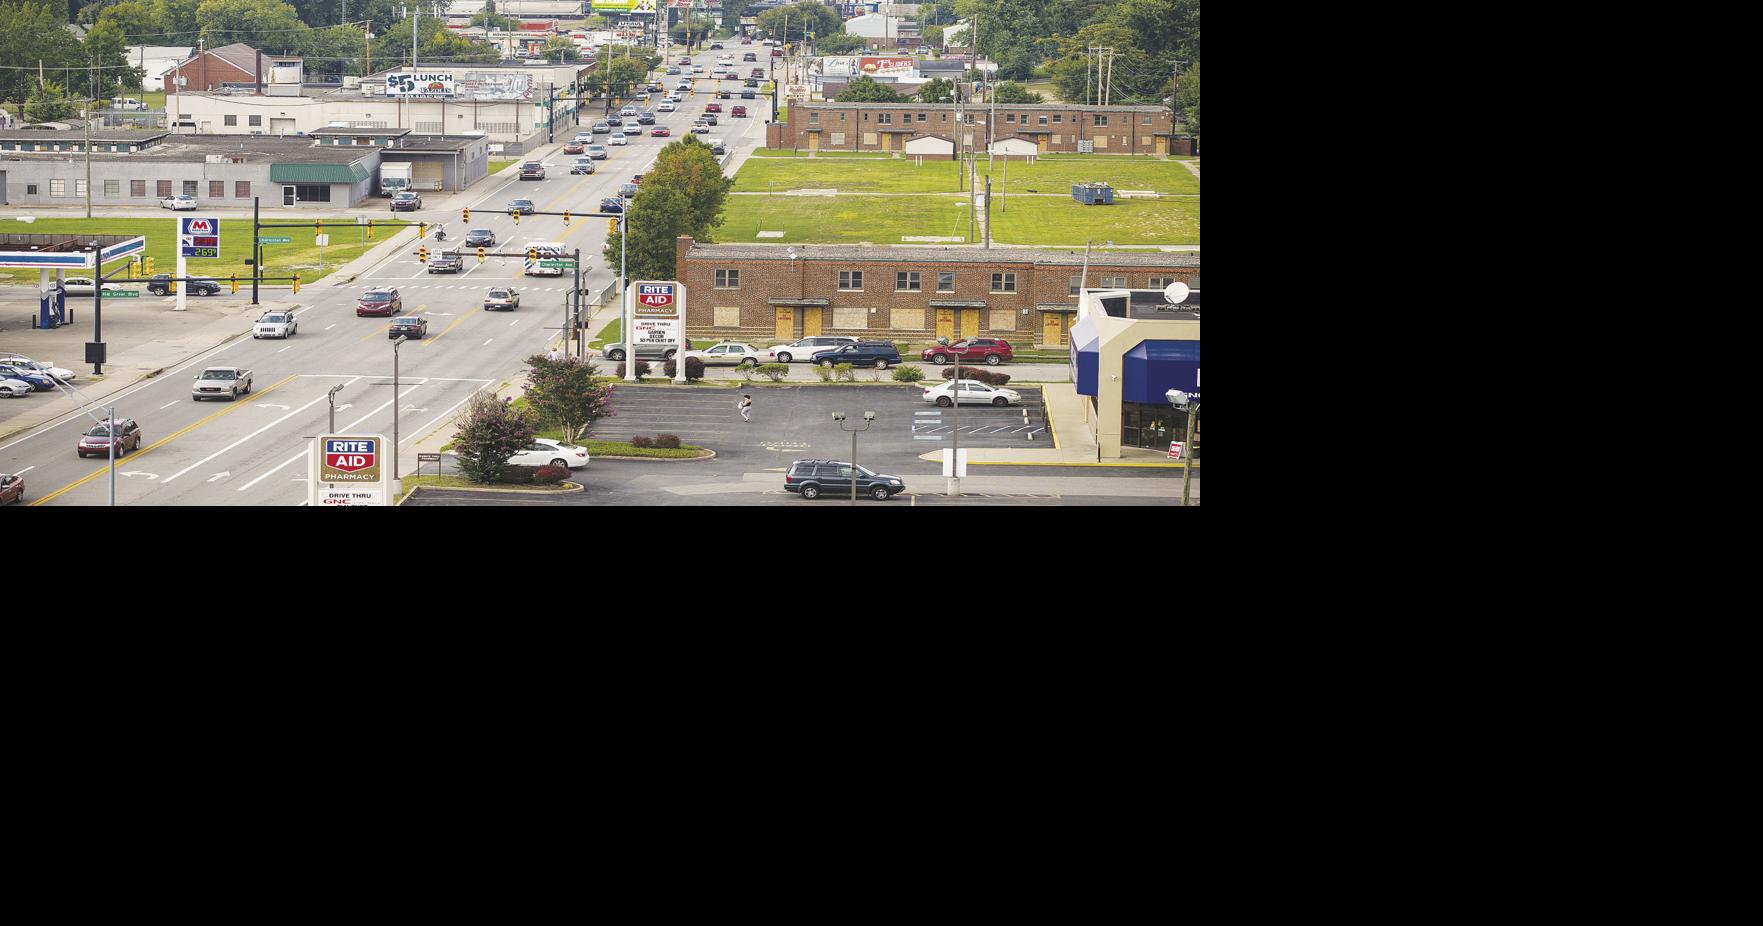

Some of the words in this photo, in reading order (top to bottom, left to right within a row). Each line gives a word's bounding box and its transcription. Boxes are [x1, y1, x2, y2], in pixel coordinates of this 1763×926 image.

[192, 221, 208, 229] M
[643, 286, 669, 294] RITE
[645, 295, 667, 304] AID
[333, 441, 369, 452] RITE
[335, 455, 366, 467] AID
